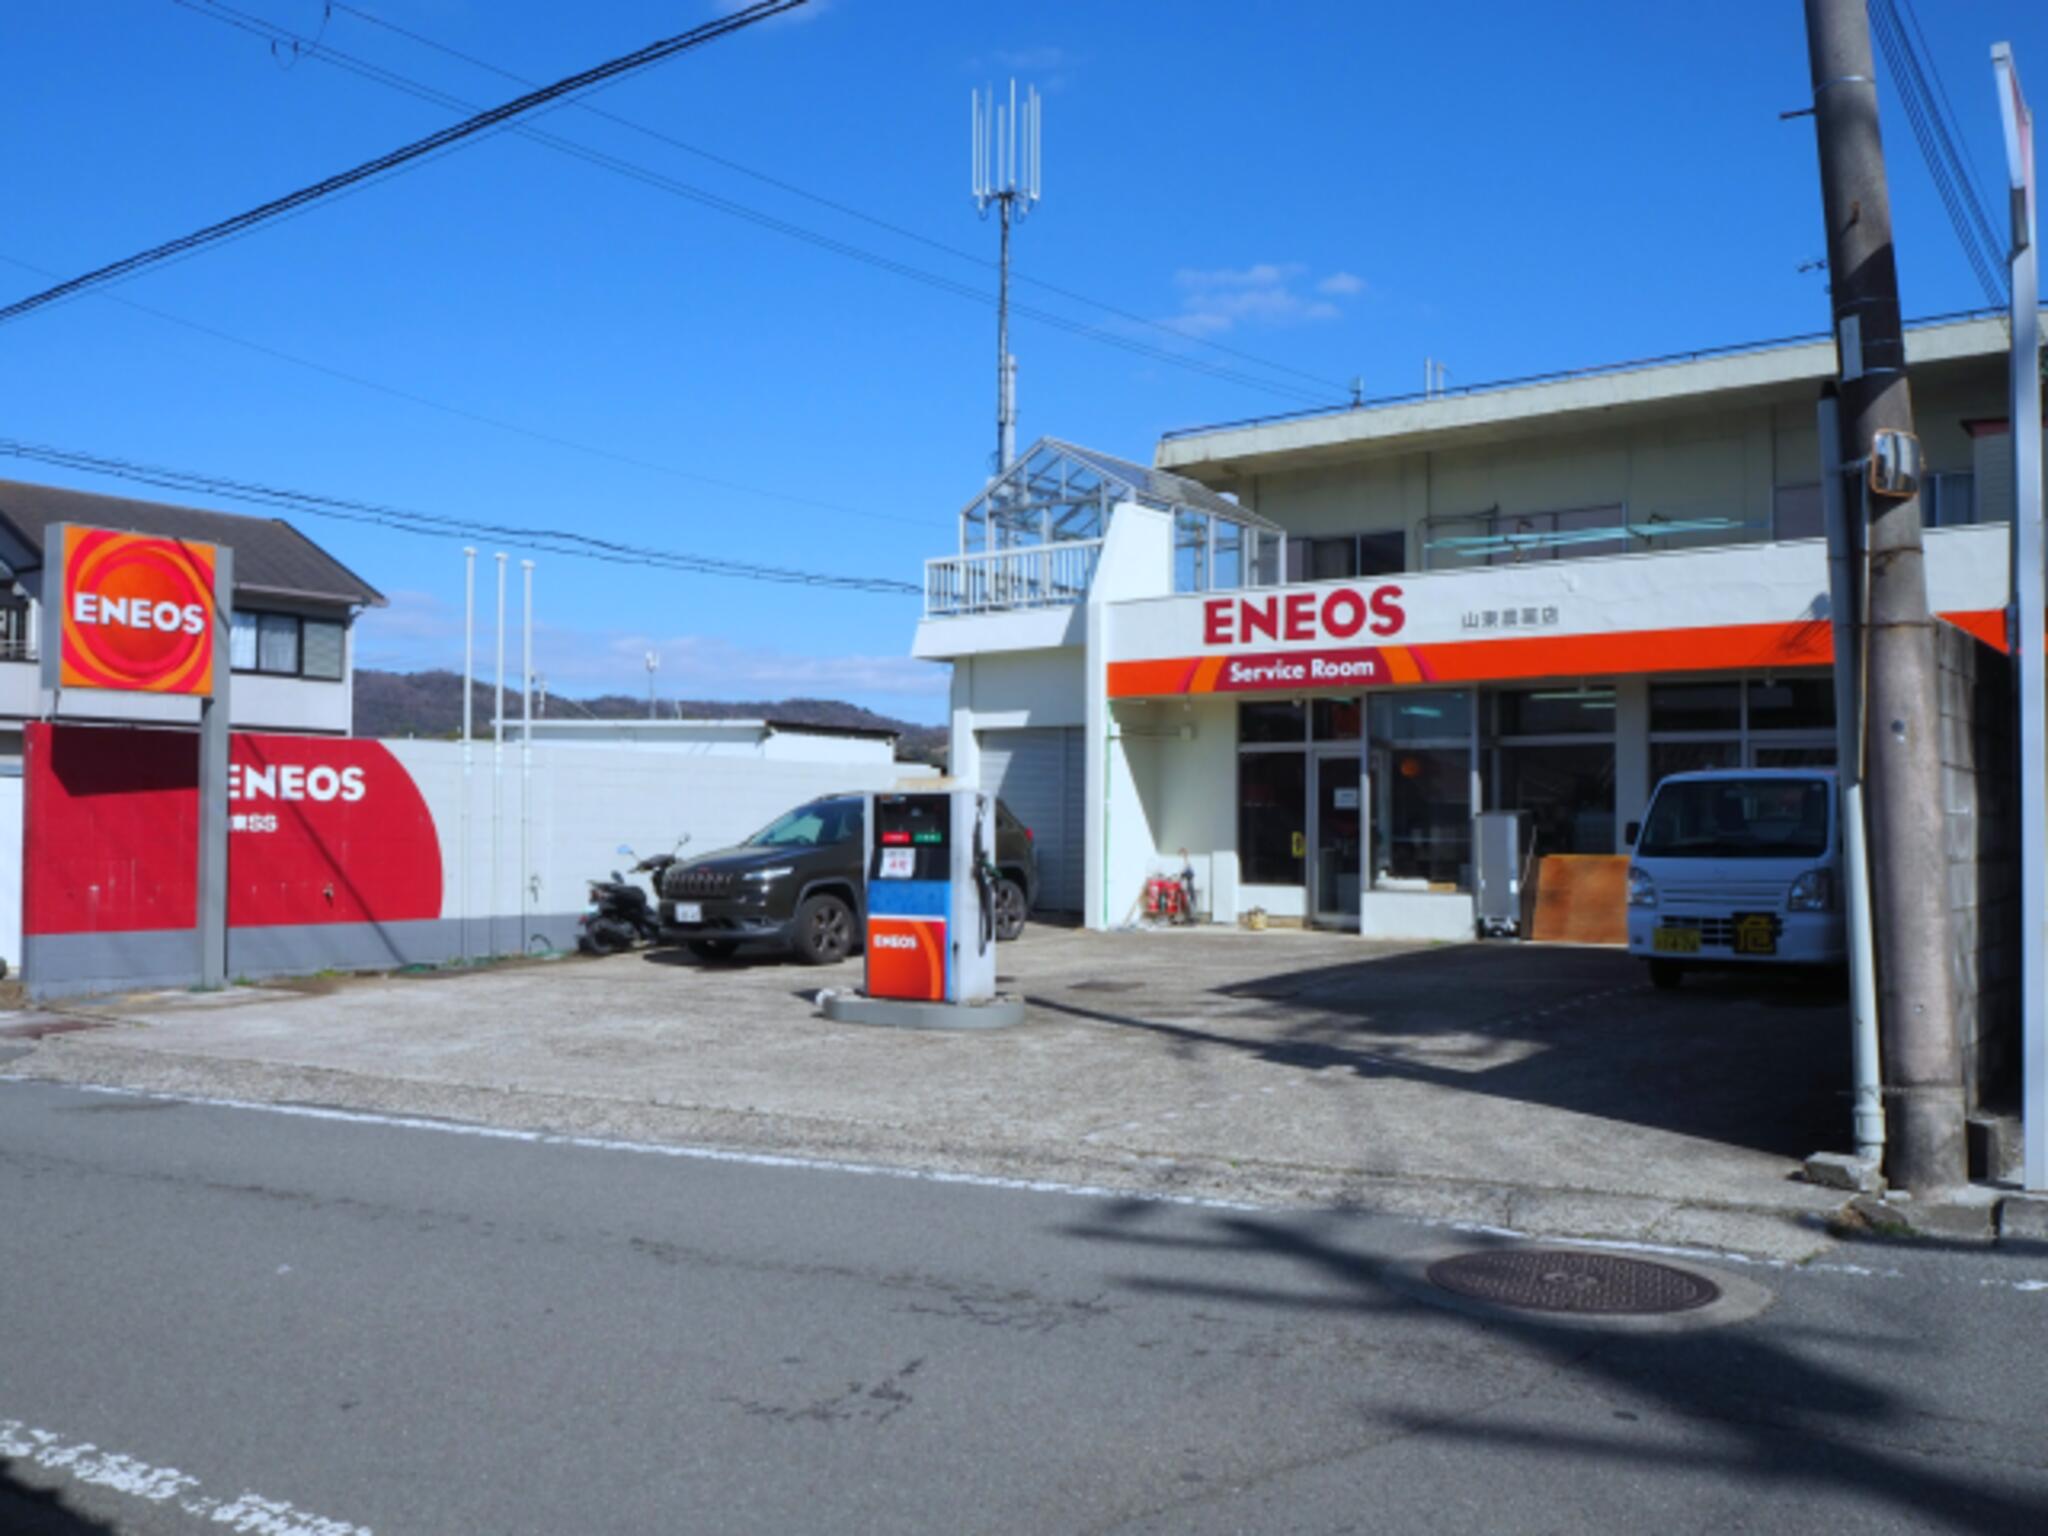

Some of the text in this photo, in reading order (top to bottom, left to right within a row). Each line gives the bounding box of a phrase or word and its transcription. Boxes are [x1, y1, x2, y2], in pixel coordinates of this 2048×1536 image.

[74, 592, 205, 634] ENEOS
[1204, 584, 1406, 645] ENEOS
[1229, 658, 1374, 682] Service Room
[873, 934, 917, 949] ENEOS
